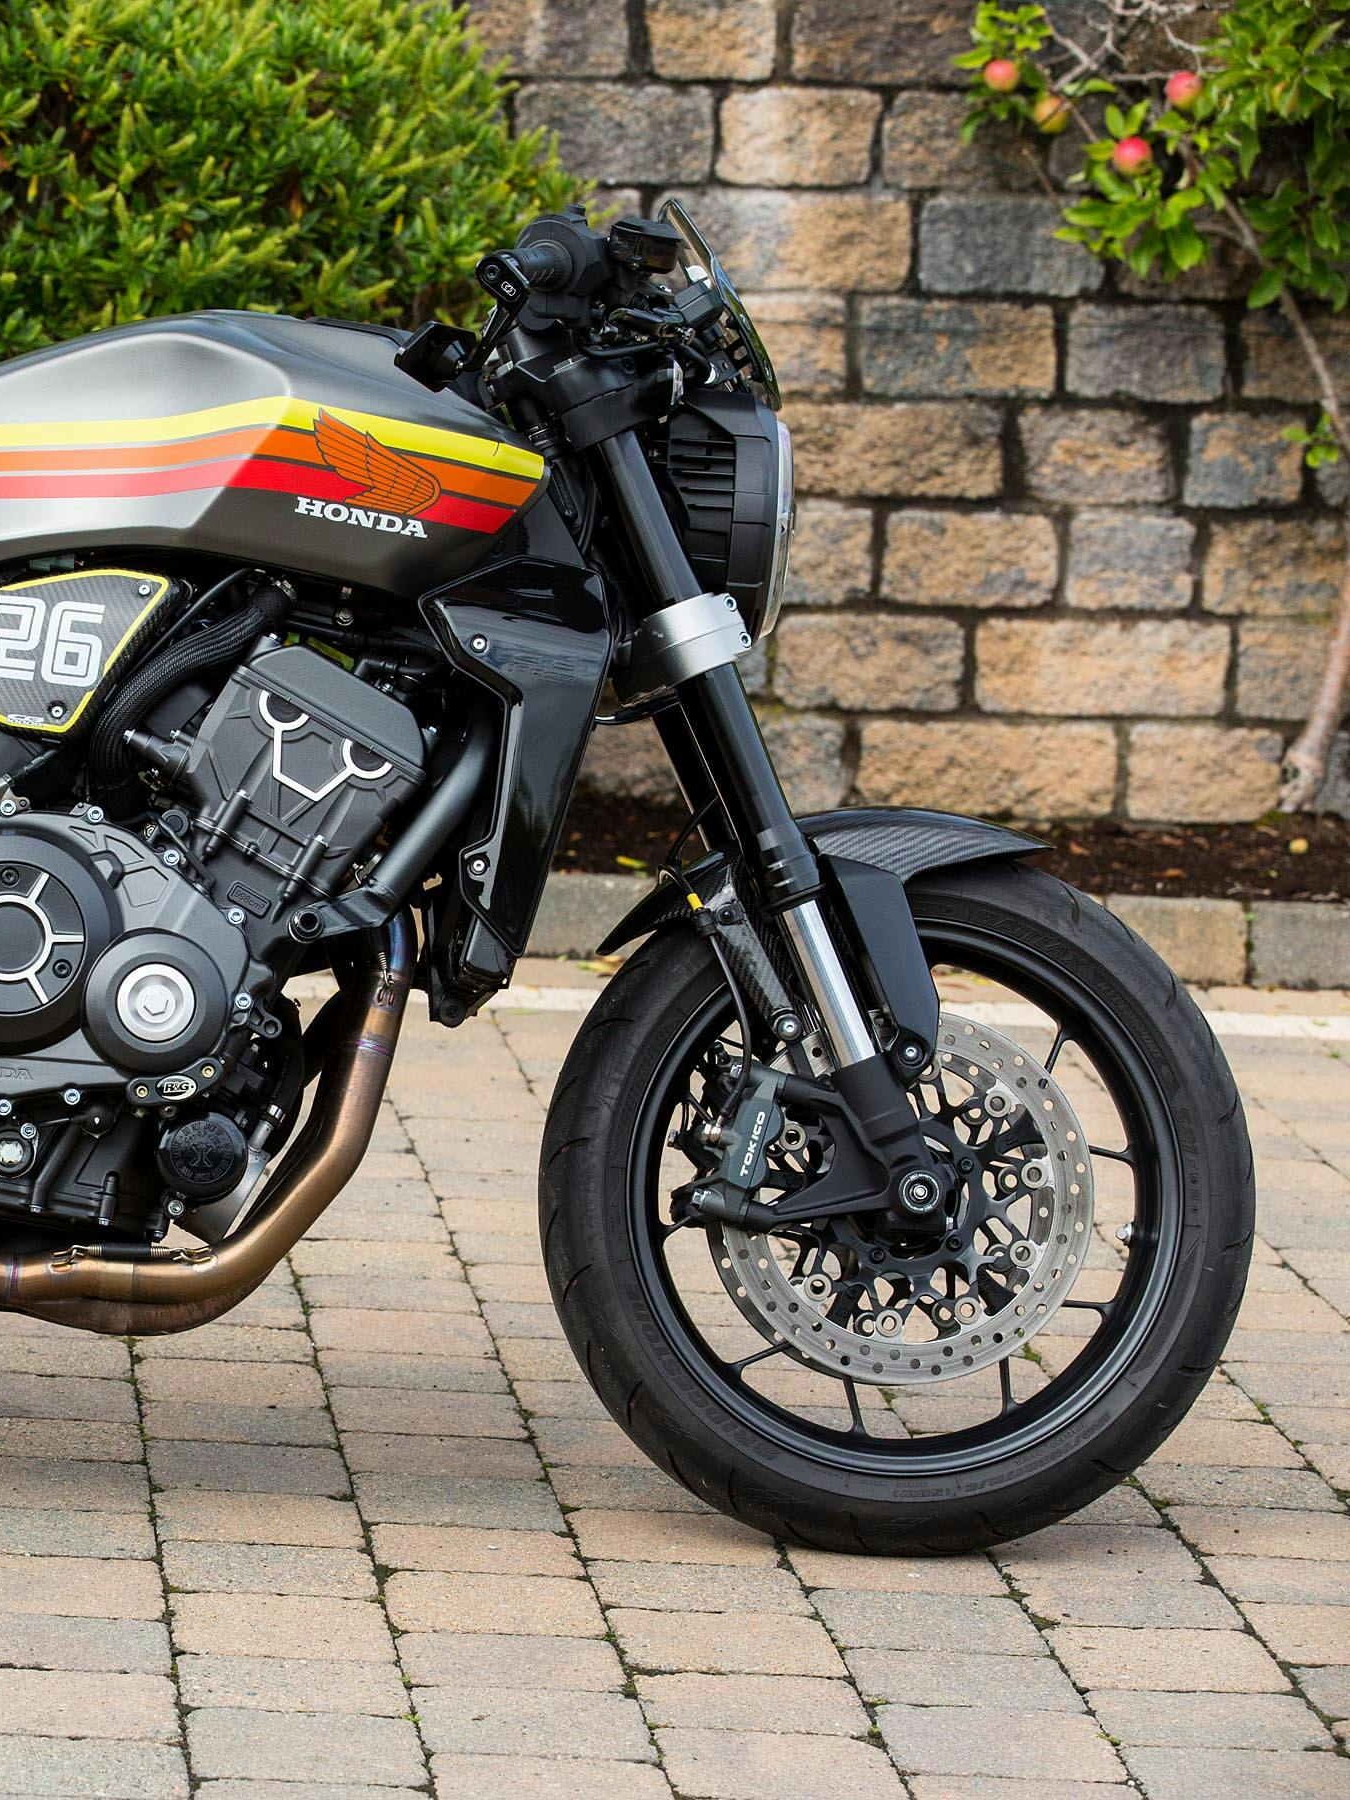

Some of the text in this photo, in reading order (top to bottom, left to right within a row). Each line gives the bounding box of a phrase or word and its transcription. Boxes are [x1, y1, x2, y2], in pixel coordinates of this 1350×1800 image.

[294, 496, 428, 538] HONDA
[164, 1081, 190, 1092] R&G
[739, 1111, 766, 1177] TOKICO
